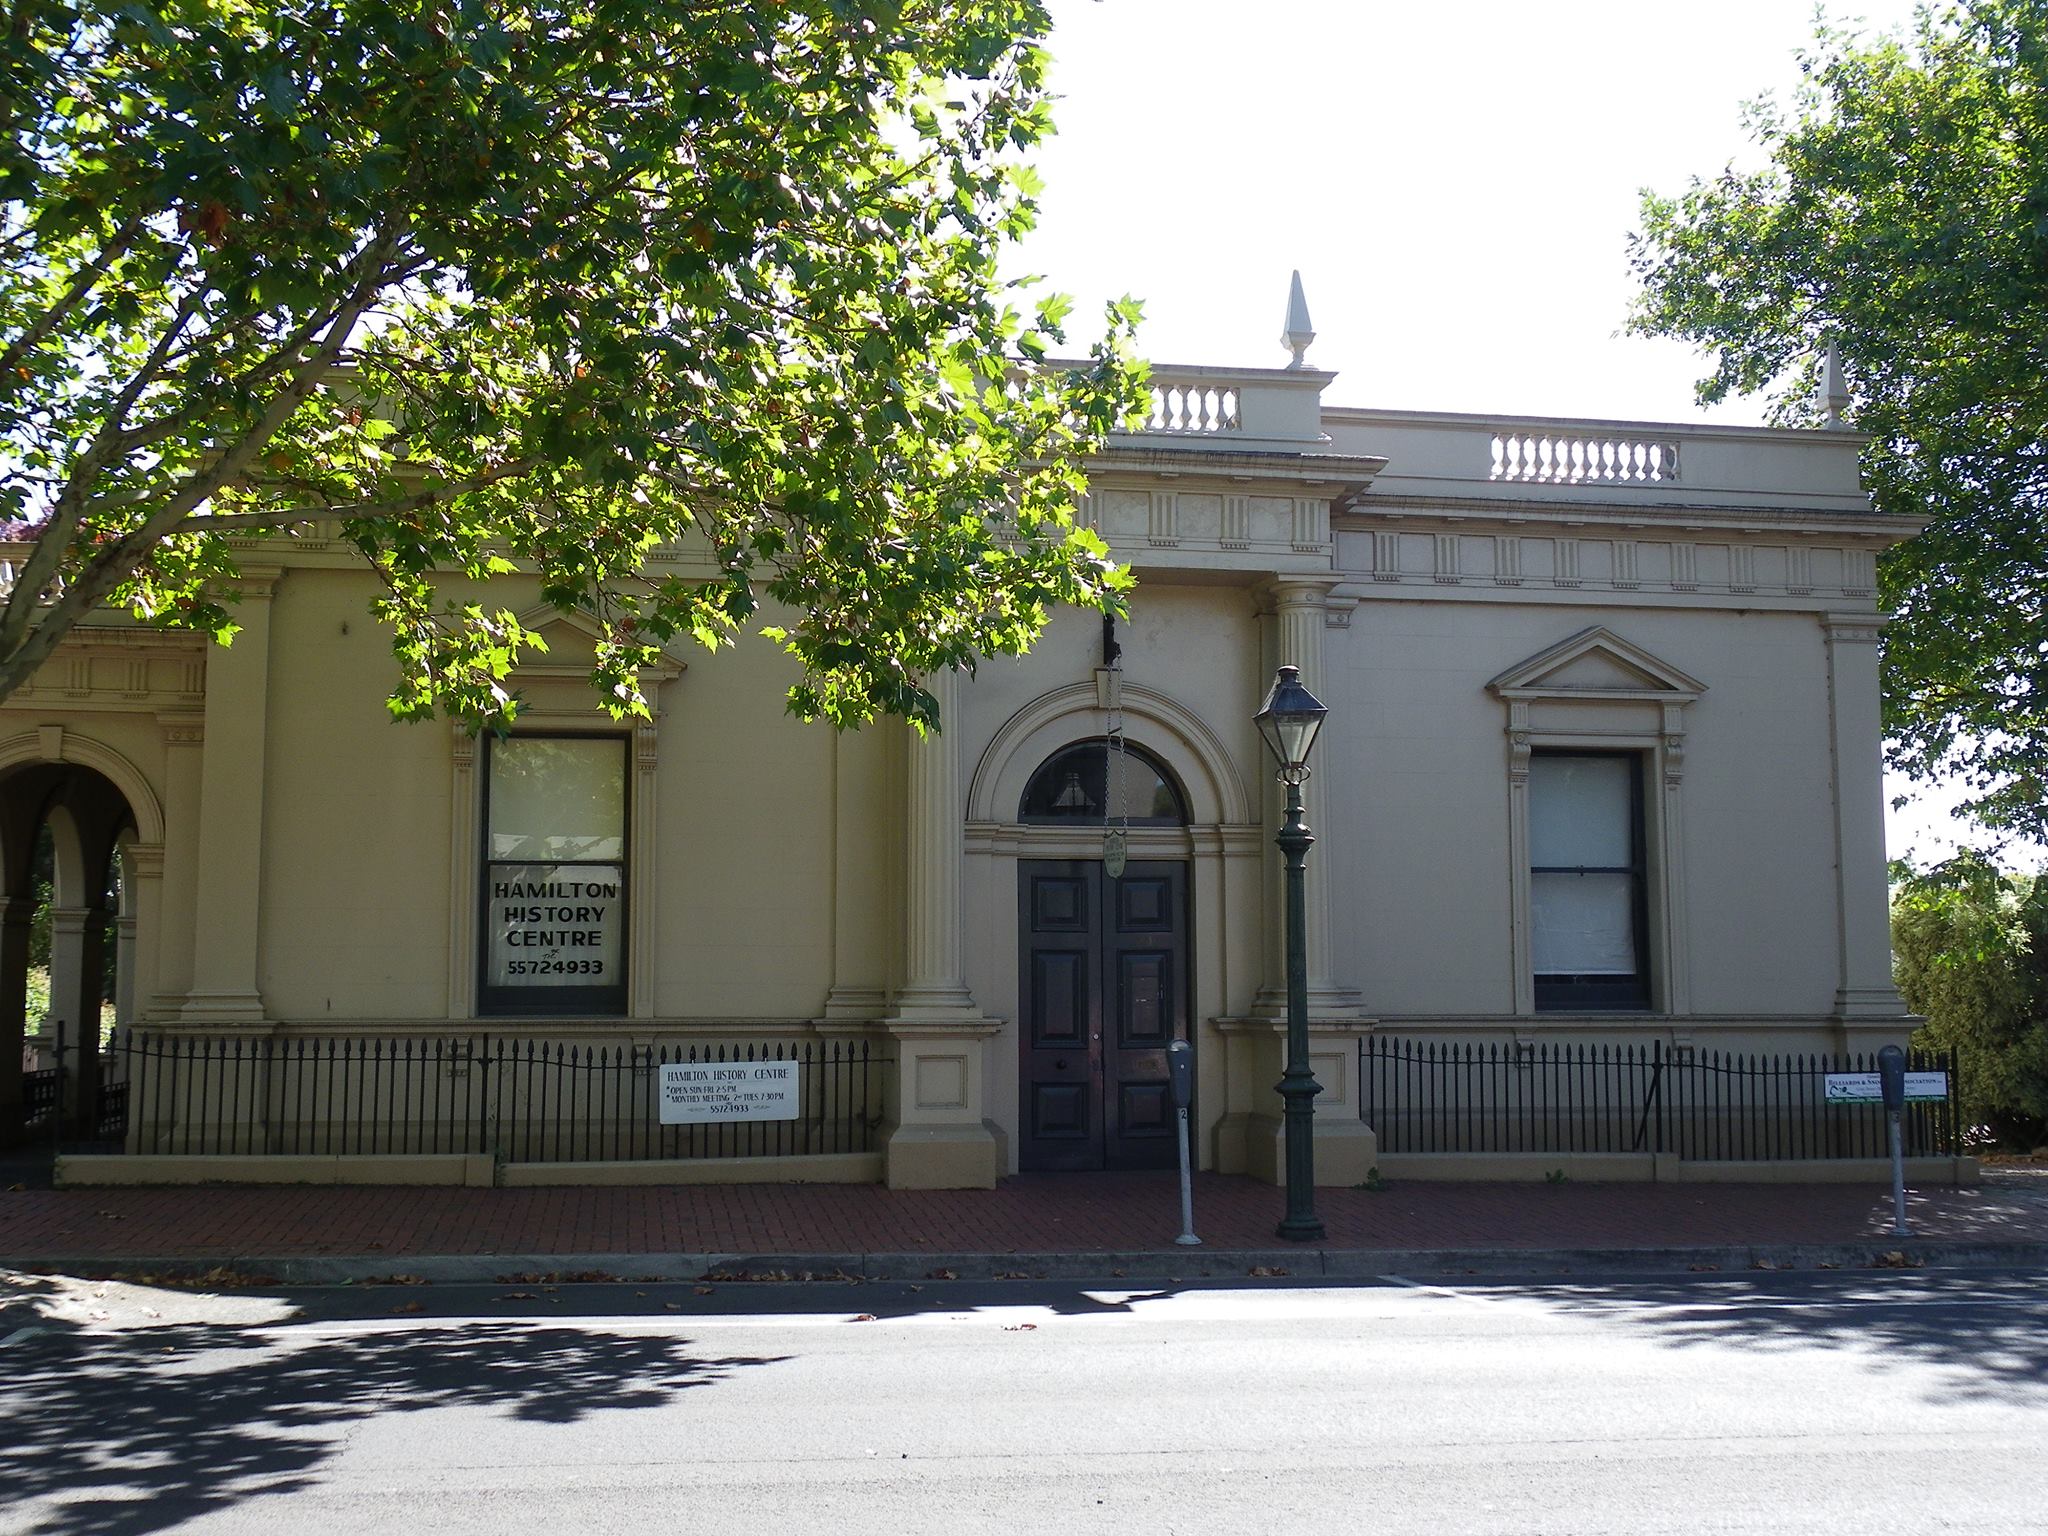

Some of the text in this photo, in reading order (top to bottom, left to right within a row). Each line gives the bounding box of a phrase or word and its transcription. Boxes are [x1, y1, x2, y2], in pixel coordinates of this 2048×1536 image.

[495, 882, 616, 898] HAMILTON
[504, 906, 605, 922] HISTORY
[507, 930, 602, 947] CENTRE
[508, 960, 603, 974] 55724933
[667, 1068, 789, 1082] HAMILTON HISTORY CENTRE
[670, 1086, 688, 1095] OPEN
[671, 1094, 700, 1103] MONTHLY
[710, 1104, 749, 1113] 55724933
